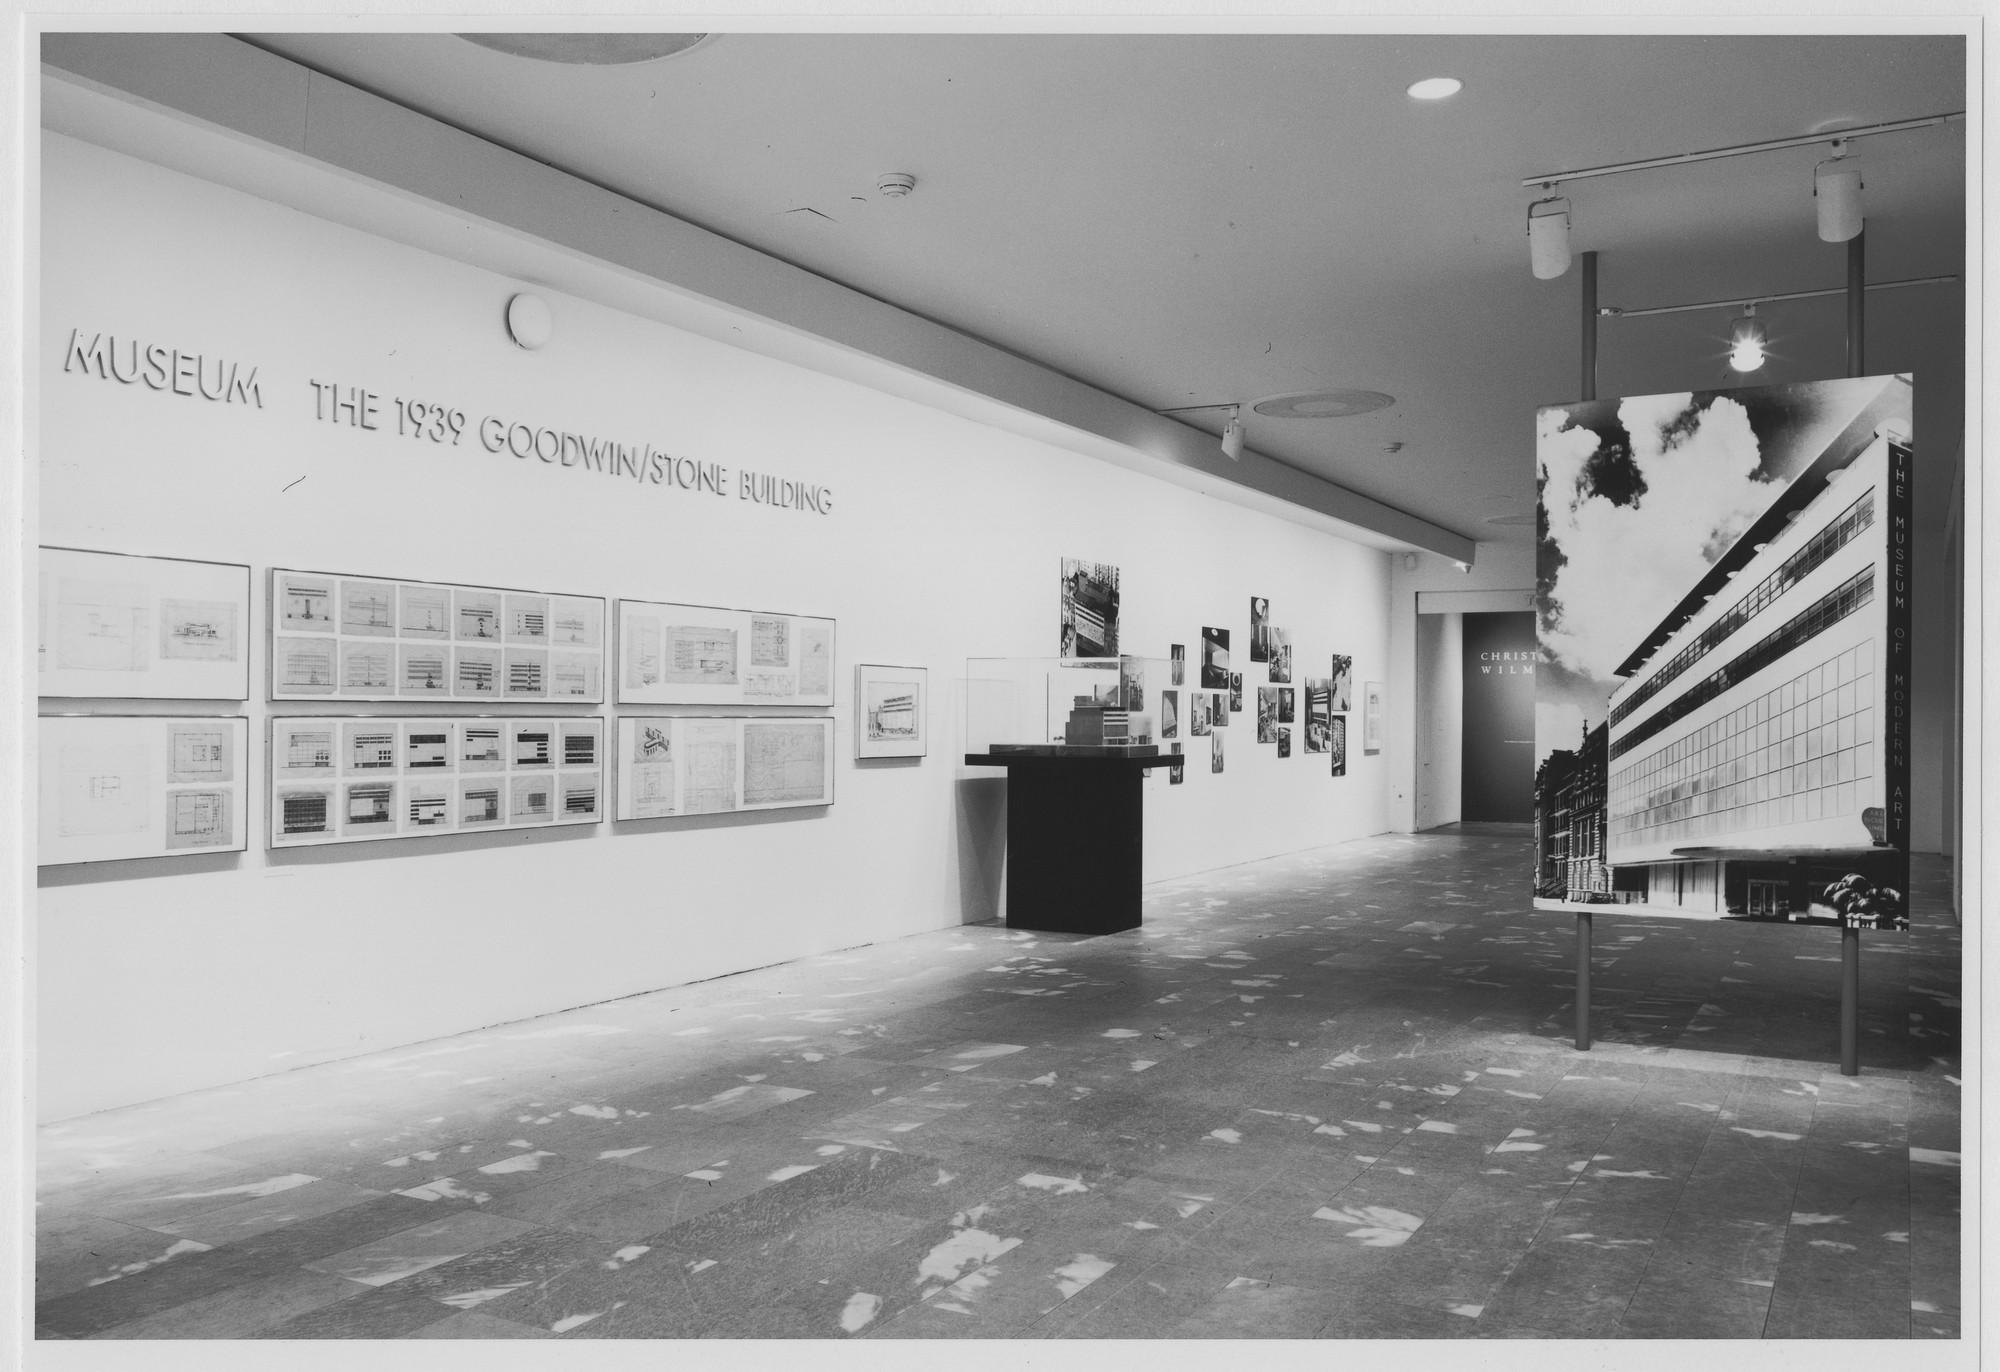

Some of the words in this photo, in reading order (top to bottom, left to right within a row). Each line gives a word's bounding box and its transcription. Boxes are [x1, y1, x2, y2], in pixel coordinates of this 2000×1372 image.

[63, 328, 263, 409] MUSEUM
[309, 378, 379, 431] THE
[394, 397, 465, 446] 1939
[480, 415, 728, 496] GOODWIN/STONE
[739, 469, 833, 515] BUILDING
[1895, 453, 1905, 498] THE
[1895, 516, 1904, 608] MUSEUM
[1894, 627, 1905, 655] OF
[1481, 665, 1533, 674] WILM
[1894, 674, 1904, 767] MODERN
[1894, 786, 1903, 830] ART
